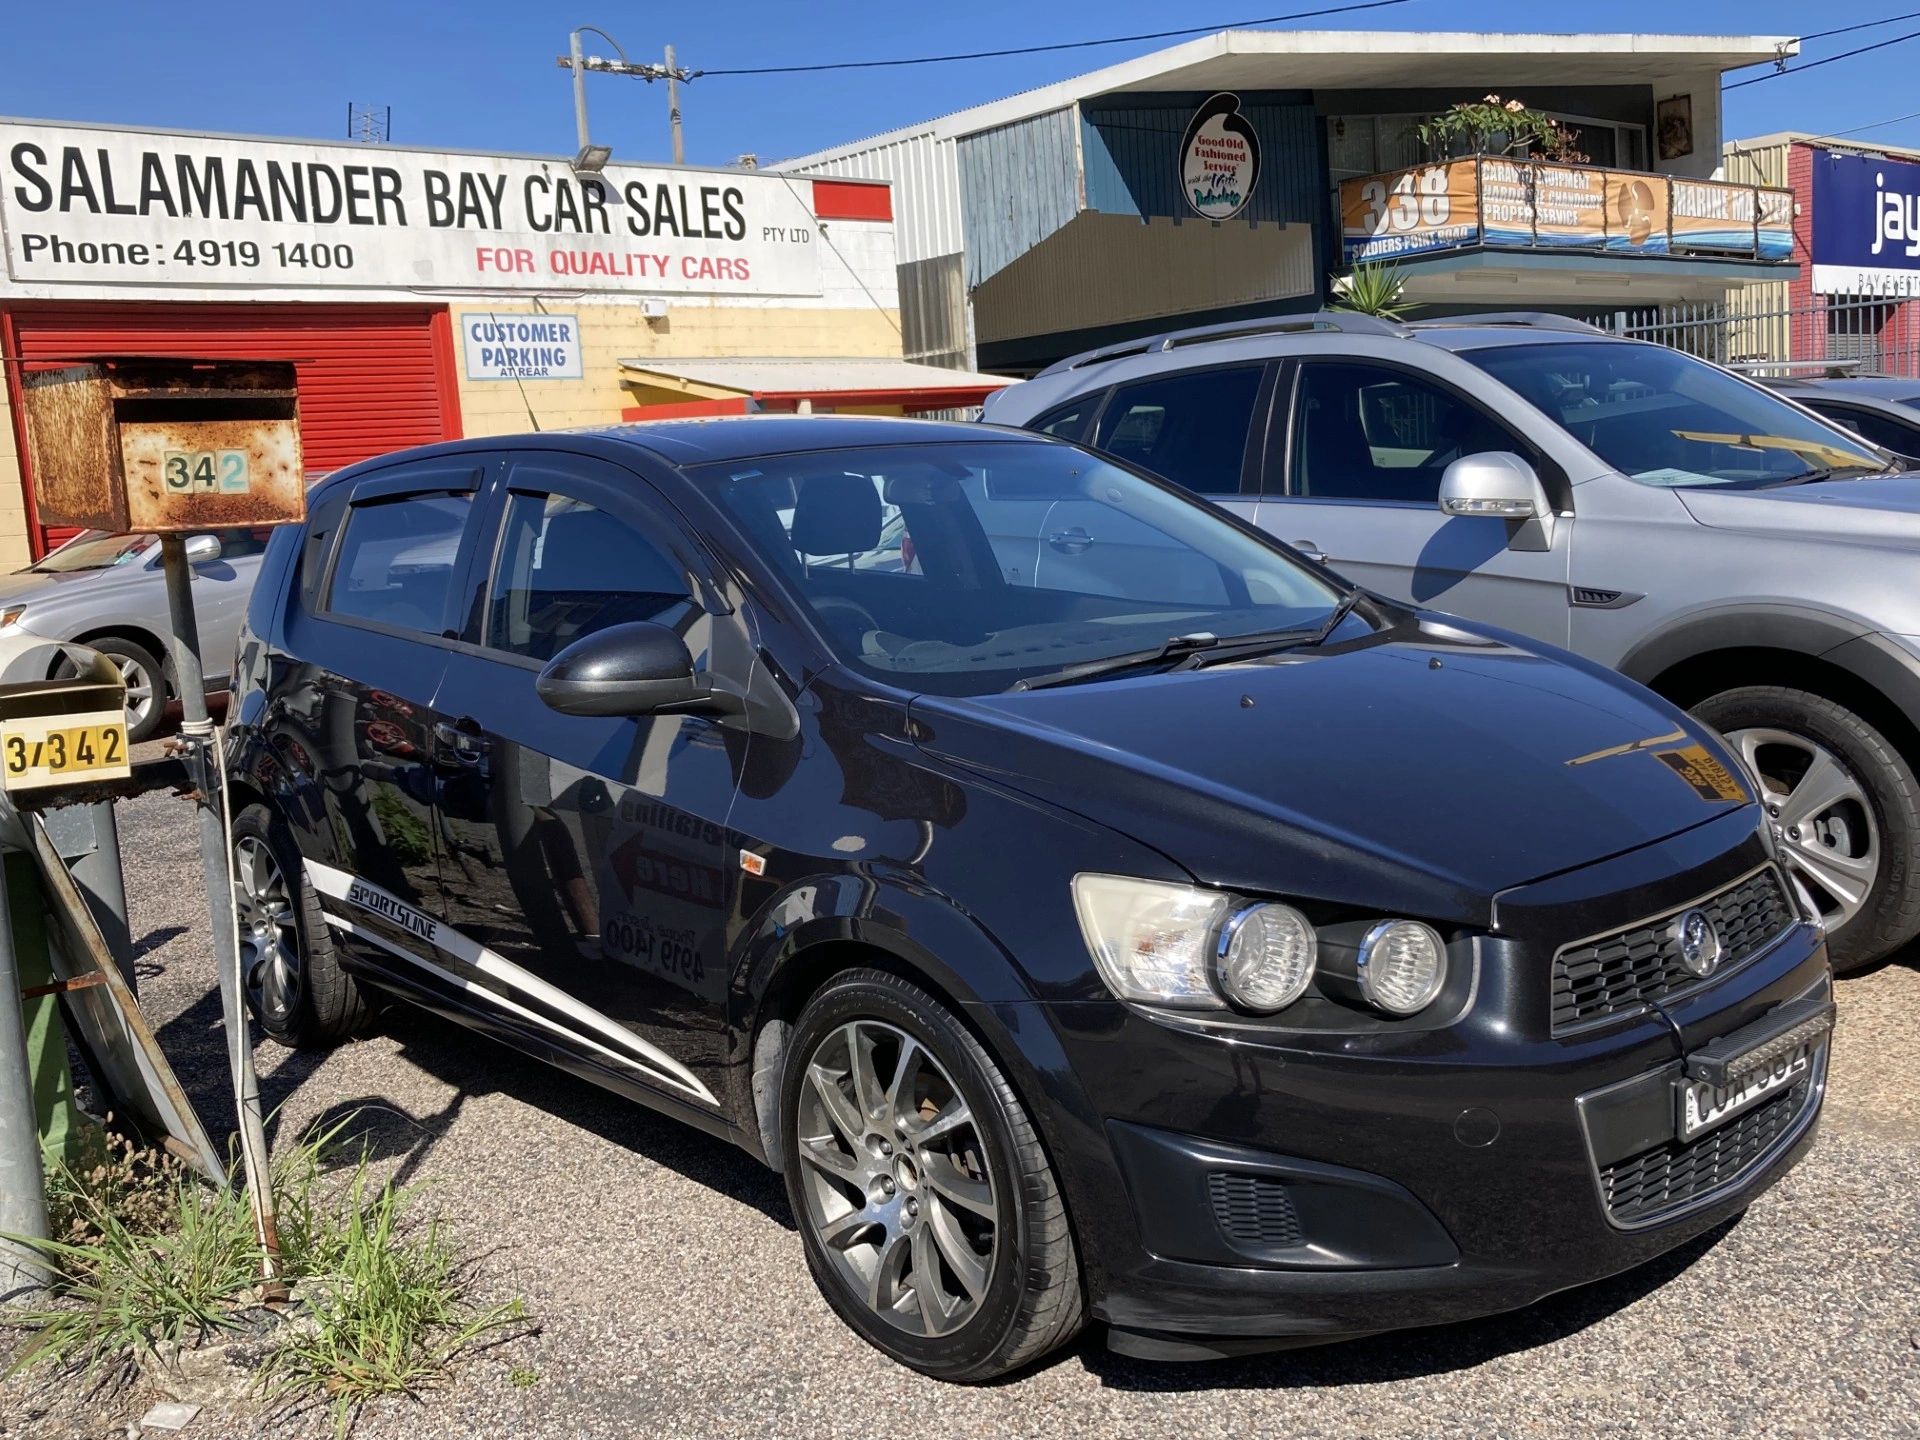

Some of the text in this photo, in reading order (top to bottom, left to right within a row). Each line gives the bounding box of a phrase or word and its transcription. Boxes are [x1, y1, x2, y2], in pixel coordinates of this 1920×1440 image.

[1194, 147, 1247, 162] Fashioned
[1226, 138, 1244, 150] Old
[10, 142, 747, 241] SALAMANDER BAY CAR SALES
[1361, 165, 1450, 236] 338
[1673, 183, 1729, 220] MARINE
[1484, 204, 1578, 226] PROPER SERVICE
[763, 227, 810, 243] PTY LTD
[21, 235, 354, 269] Phone: 4919 1400
[476, 248, 750, 281] FOR QUALITY CARS
[1858, 274, 1880, 288] BAY
[471, 323, 571, 342] CUSTOMER
[481, 347, 566, 367] PARKING
[500, 367, 549, 377] AT REAR
[167, 455, 246, 489] 342
[7, 728, 122, 773] 3/342
[349, 883, 437, 942] SPORTSLINE
